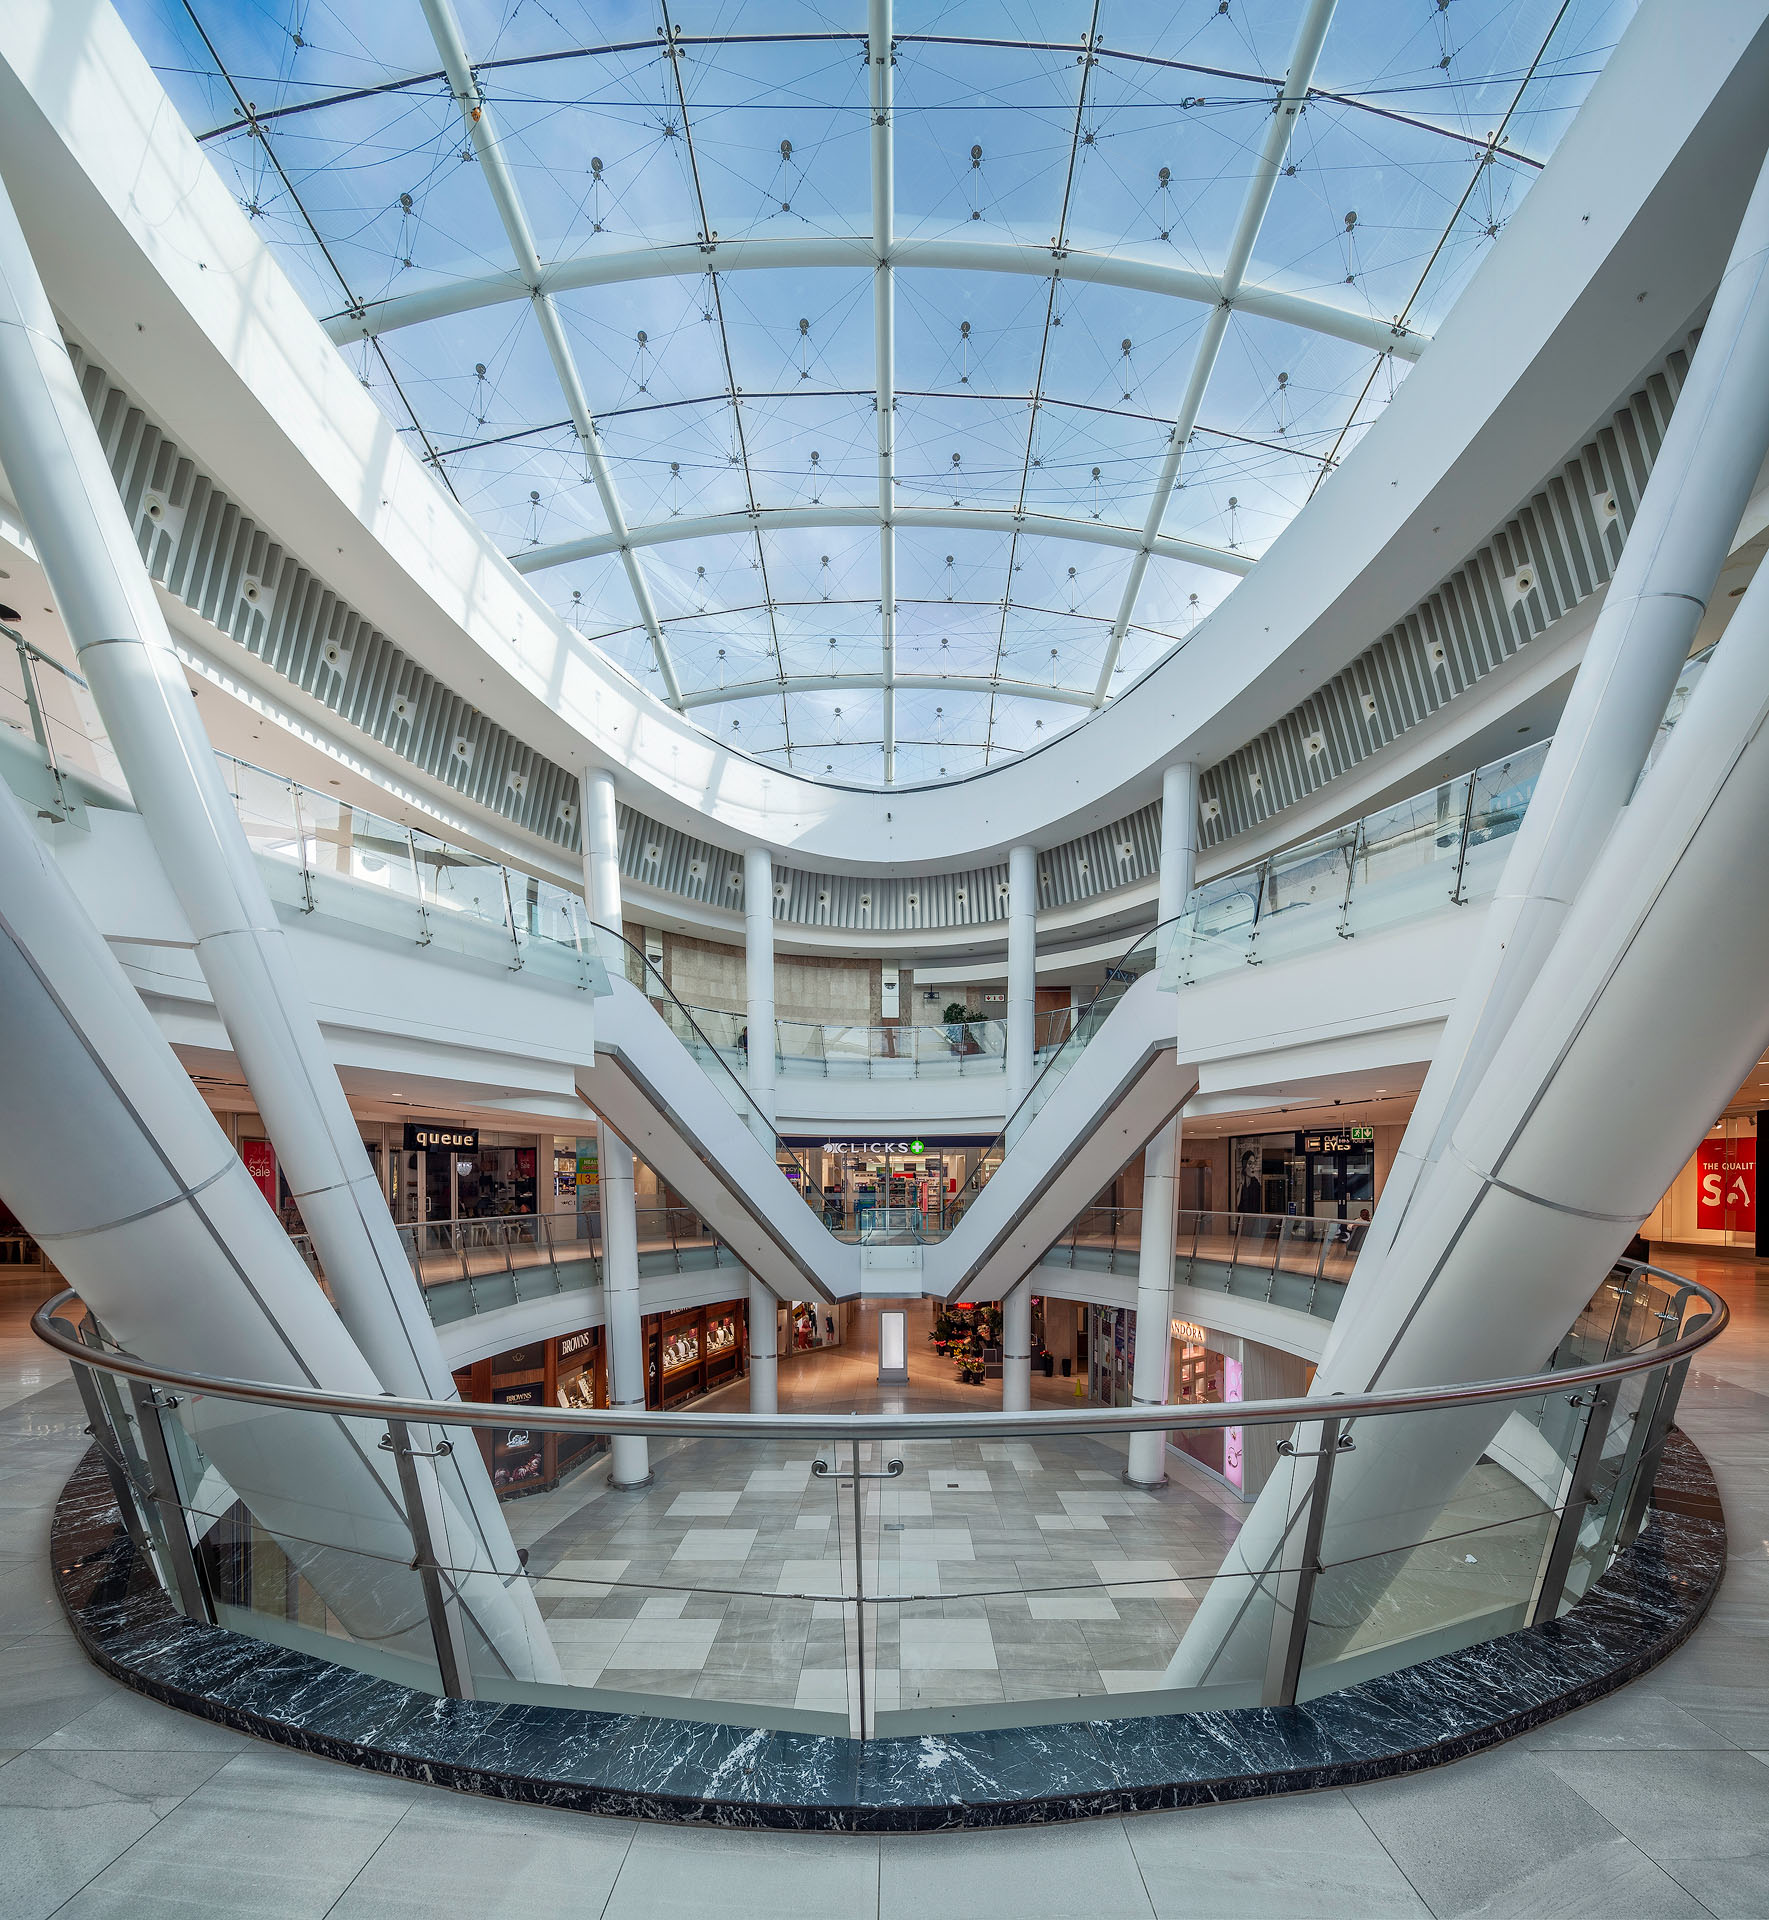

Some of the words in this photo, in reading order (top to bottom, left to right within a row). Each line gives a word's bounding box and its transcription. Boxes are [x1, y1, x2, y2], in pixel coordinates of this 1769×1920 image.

[416, 1132, 474, 1147] queue
[838, 1142, 909, 1154] CLICKS
[249, 1166, 270, 1177] Sale
[1703, 1162, 1719, 1170] THE
[1721, 1162, 1756, 1171] QUALIT
[562, 1332, 589, 1355] BROWNS
[506, 1392, 531, 1402] BROWNS
